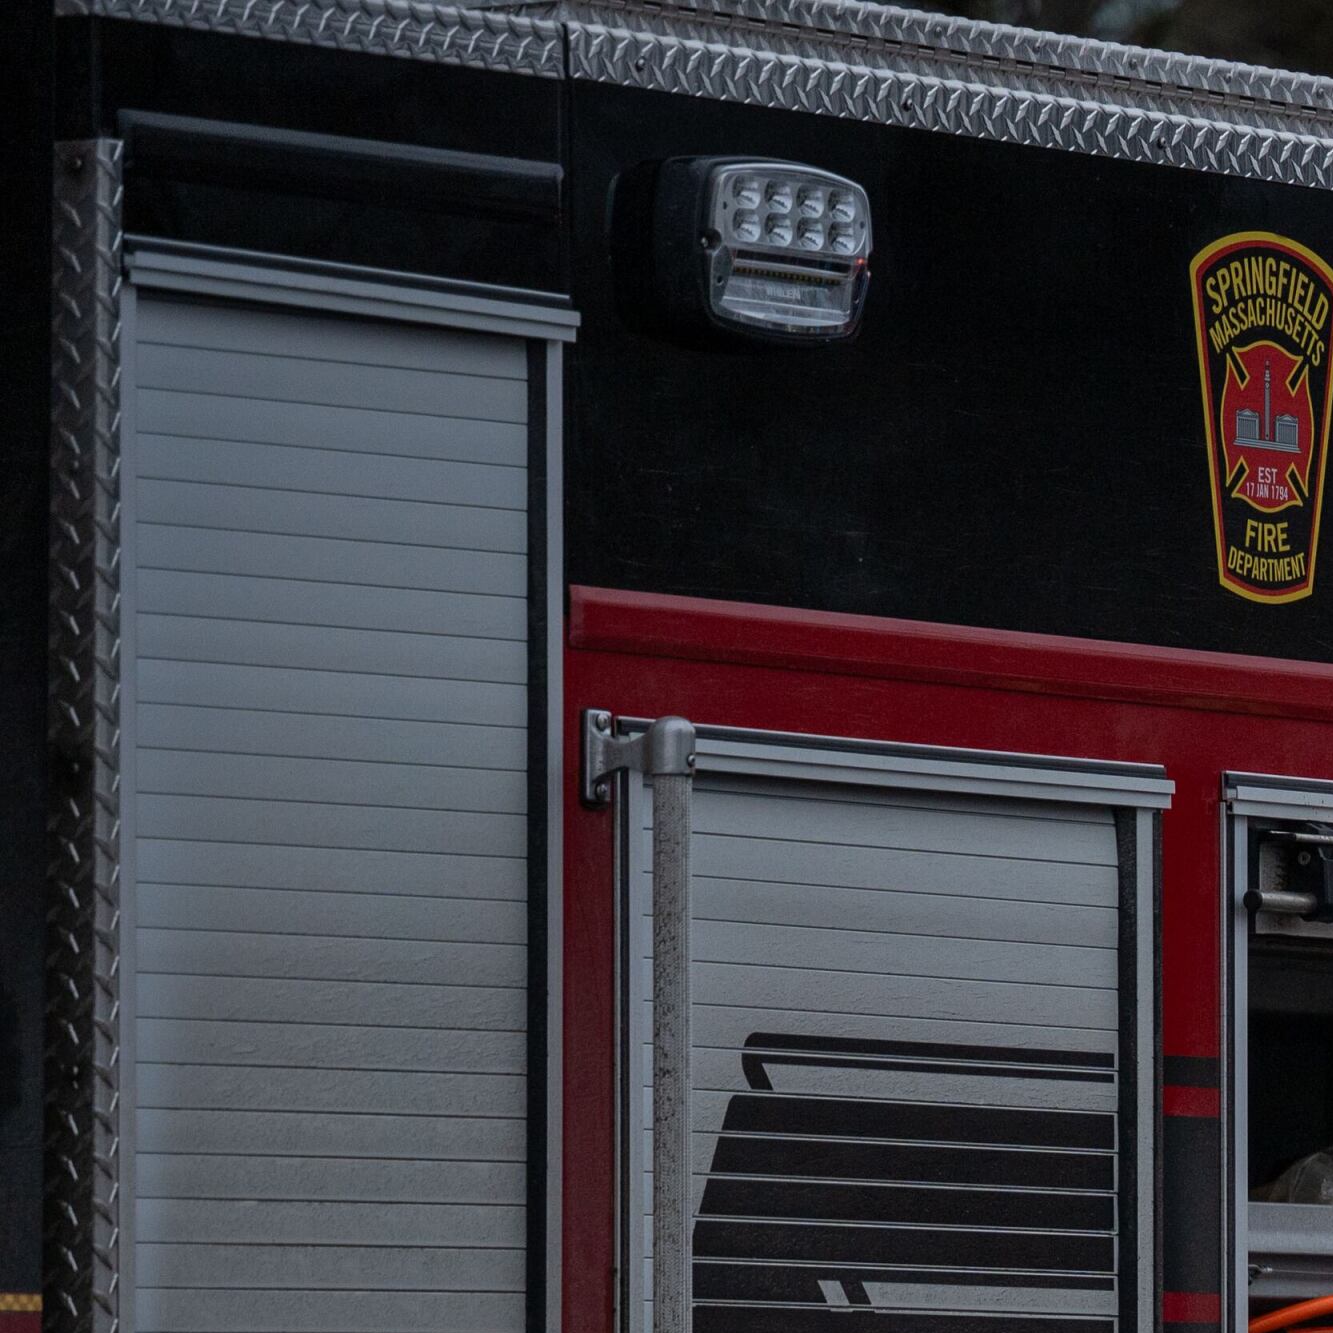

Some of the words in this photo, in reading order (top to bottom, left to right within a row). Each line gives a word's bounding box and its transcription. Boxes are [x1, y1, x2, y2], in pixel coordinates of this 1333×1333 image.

[1206, 255, 1329, 331] SPRINGFIELD
[1208, 297, 1326, 367] MASSACHUSETTS
[1245, 482, 1255, 498] 17
[1256, 484, 1270, 500] JAN
[1271, 484, 1289, 501] 1794
[1257, 466, 1279, 485] EST
[1245, 518, 1291, 554] FIRE
[1227, 545, 1307, 582] DEPARTMENT
